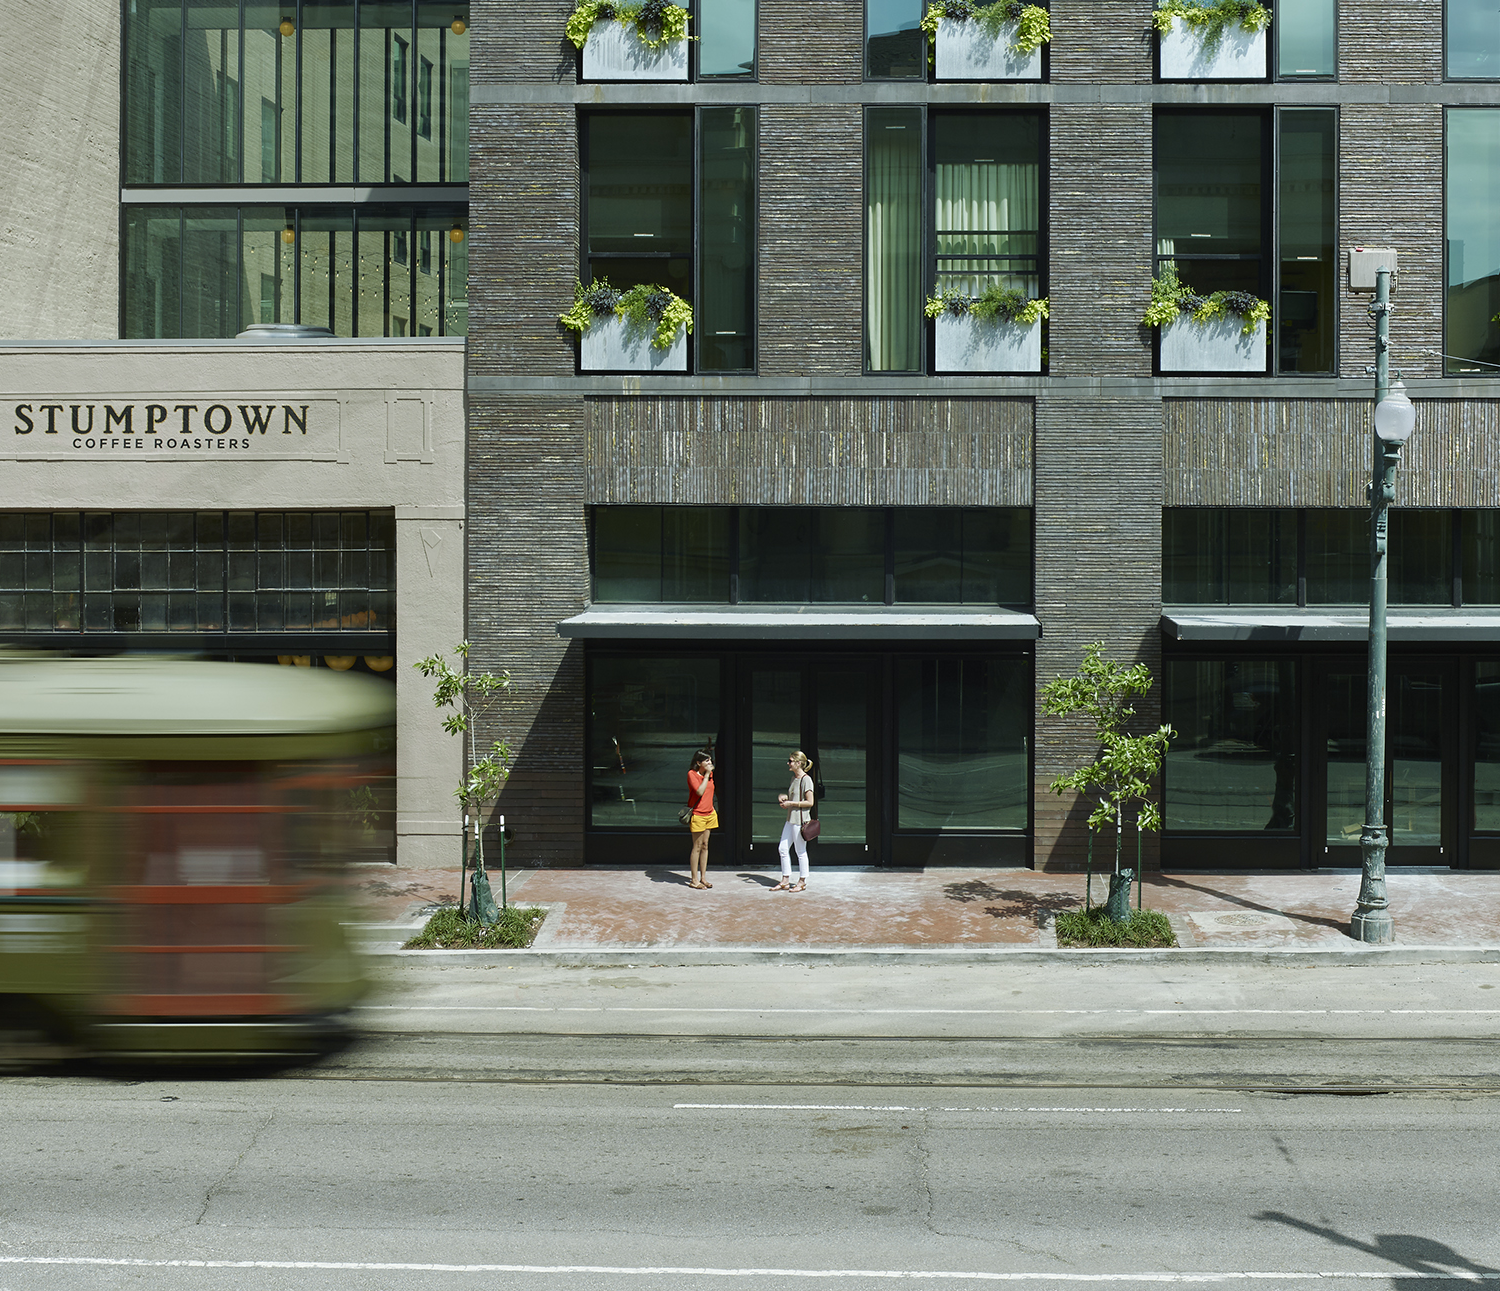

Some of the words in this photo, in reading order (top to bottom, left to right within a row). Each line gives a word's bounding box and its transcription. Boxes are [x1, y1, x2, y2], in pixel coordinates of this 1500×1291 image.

[14, 404, 310, 435] STUMPTOWN
[72, 438, 144, 449] COFFEE
[154, 438, 251, 449] ROASTERS
